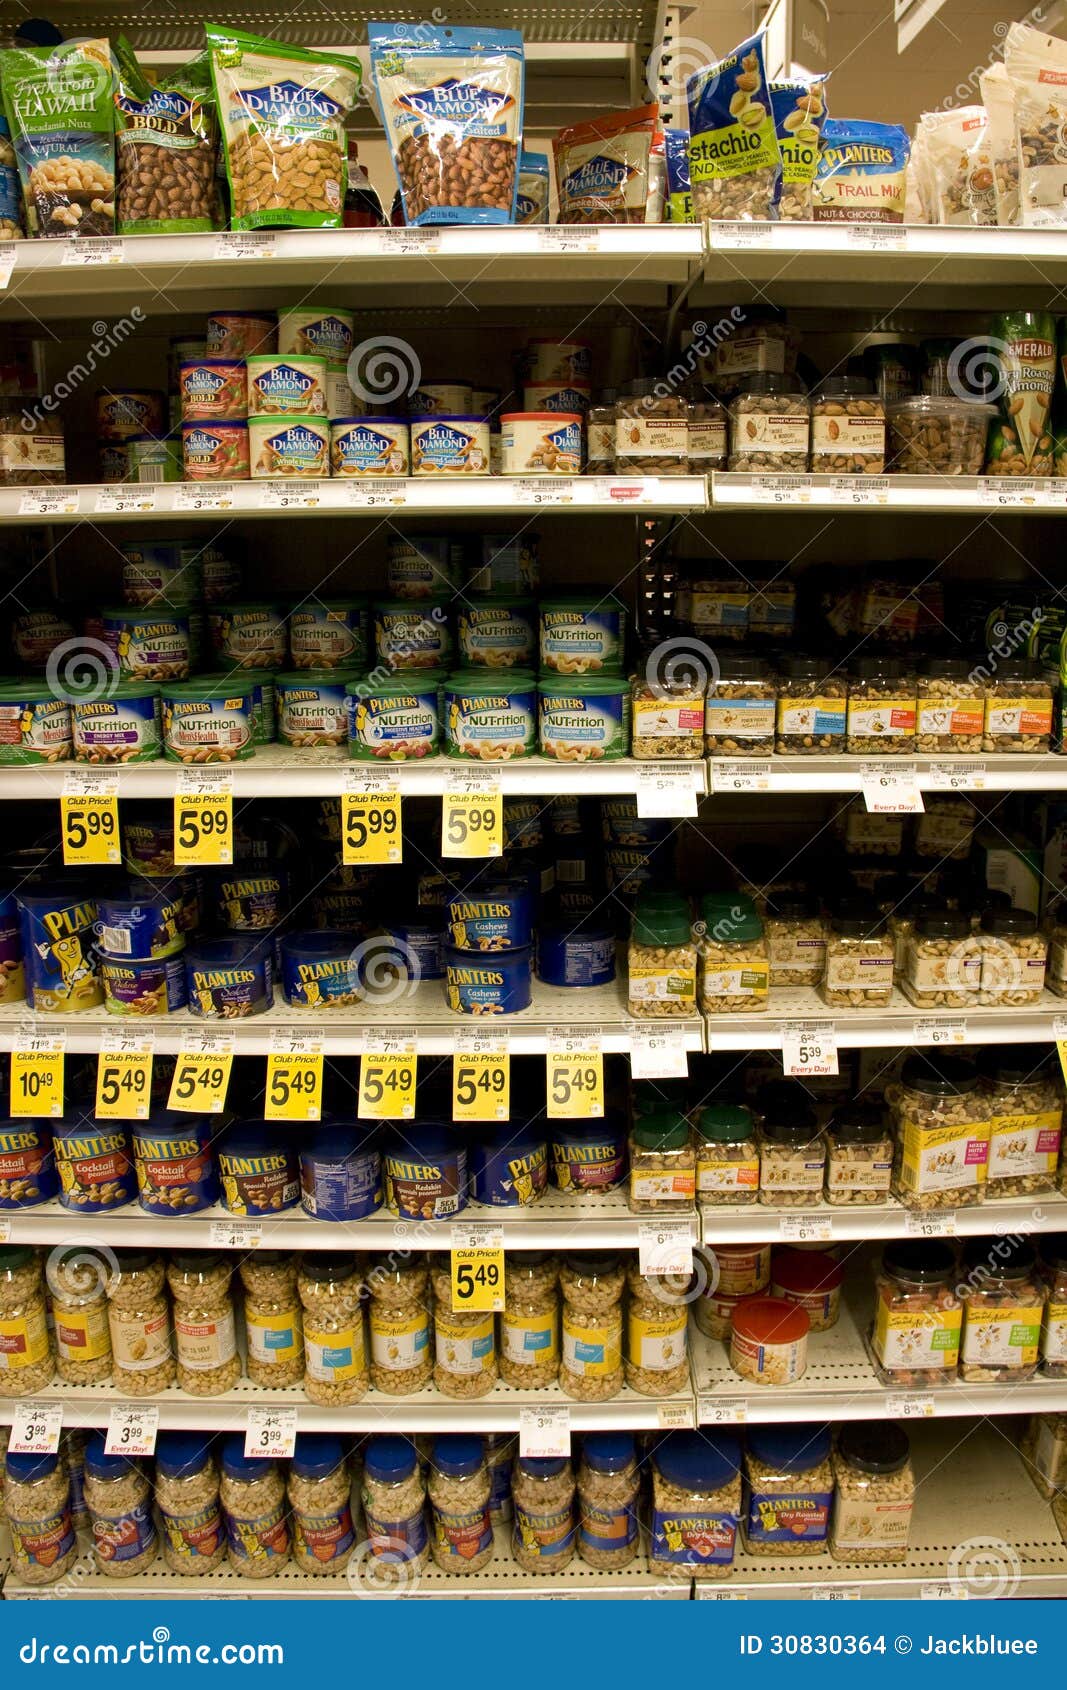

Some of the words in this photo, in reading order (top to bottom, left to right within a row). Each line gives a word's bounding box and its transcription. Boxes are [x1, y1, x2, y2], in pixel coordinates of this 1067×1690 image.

[60, 77, 95, 92] from
[269, 85, 317, 104] BLUE
[433, 86, 480, 102] BLUE
[12, 92, 97, 117] HAWAII
[246, 93, 339, 116] DIAMOND
[411, 97, 505, 113] DIAMOND
[68, 118, 92, 129] Nuts
[133, 116, 178, 134] BOLD
[826, 146, 895, 168] PLANTERS
[582, 160, 610, 178] BLUE
[565, 168, 626, 193] DIAMOND
[836, 182, 878, 198] TRAIL
[880, 182, 904, 198] MIX
[819, 209, 838, 220] NUT
[321, 320, 343, 331] BLUE
[306, 328, 350, 343] DIAMOND
[1009, 343, 1053, 357] EMERALD
[192, 372, 212, 381] BLUE
[271, 369, 299, 381] BLUE
[184, 378, 225, 390] DIAMOND
[258, 378, 312, 391] DIAMOND
[190, 394, 215, 402] BOLD
[189, 432, 207, 442] BLUE
[287, 430, 313, 442] BLUE
[350, 431, 376, 442] BLUE
[428, 428, 453, 440] BLUE
[185, 440, 220, 451] DIAMOND
[273, 439, 323, 451] DIAMOND
[339, 440, 389, 452] DIAMOND
[418, 437, 468, 449] DIAMOND
[188, 455, 209, 463] BOLD
[470, 610, 511, 625] PLANTERS
[545, 613, 583, 628] PLANTERS
[134, 624, 177, 640] PLANTERS
[285, 691, 319, 701] PLANTERS
[75, 703, 116, 716] PLANTERS
[174, 703, 211, 714] PLANTERS
[226, 700, 241, 709] NEW!
[370, 697, 418, 713] PLANTERS
[462, 697, 509, 713] PLANTERS
[544, 697, 584, 712] PLANTERS
[67, 797, 87, 805] Club
[88, 797, 113, 805] Price!
[181, 796, 201, 804] Club
[202, 796, 227, 804] Price!
[348, 795, 368, 803] Club
[370, 794, 396, 802] Price!
[450, 795, 469, 803] Club
[471, 794, 497, 802] Price!
[874, 804, 897, 812] Every
[221, 880, 280, 899] PLANTERS
[451, 903, 511, 922] PLANTERS
[475, 922, 508, 930] Cashews
[298, 960, 357, 983] PLANTERS
[193, 970, 255, 989] PLANTERS
[467, 989, 500, 998] Cashews
[17, 1053, 36, 1061] Club
[37, 1053, 59, 1061] Price!
[126, 1054, 148, 1062] Price!
[460, 1055, 480, 1063] Club
[482, 1055, 505, 1063] Price!
[791, 1066, 812, 1074] Every
[814, 1065, 831, 1073] Day!
[53, 1133, 126, 1160] PLANTERS
[133, 1136, 199, 1160] PLANTERS
[553, 1143, 616, 1164] PLANTERS
[76, 1161, 114, 1173] Cocktail
[148, 1164, 184, 1174] Cocktail
[219, 1154, 288, 1176] PLANTERS
[88, 1169, 115, 1179] peanuts
[158, 1173, 185, 1182] peanuts
[416, 1183, 441, 1191] Redskin
[15, 1443, 33, 1451] Every
[758, 1500, 816, 1513] PLANTERS
